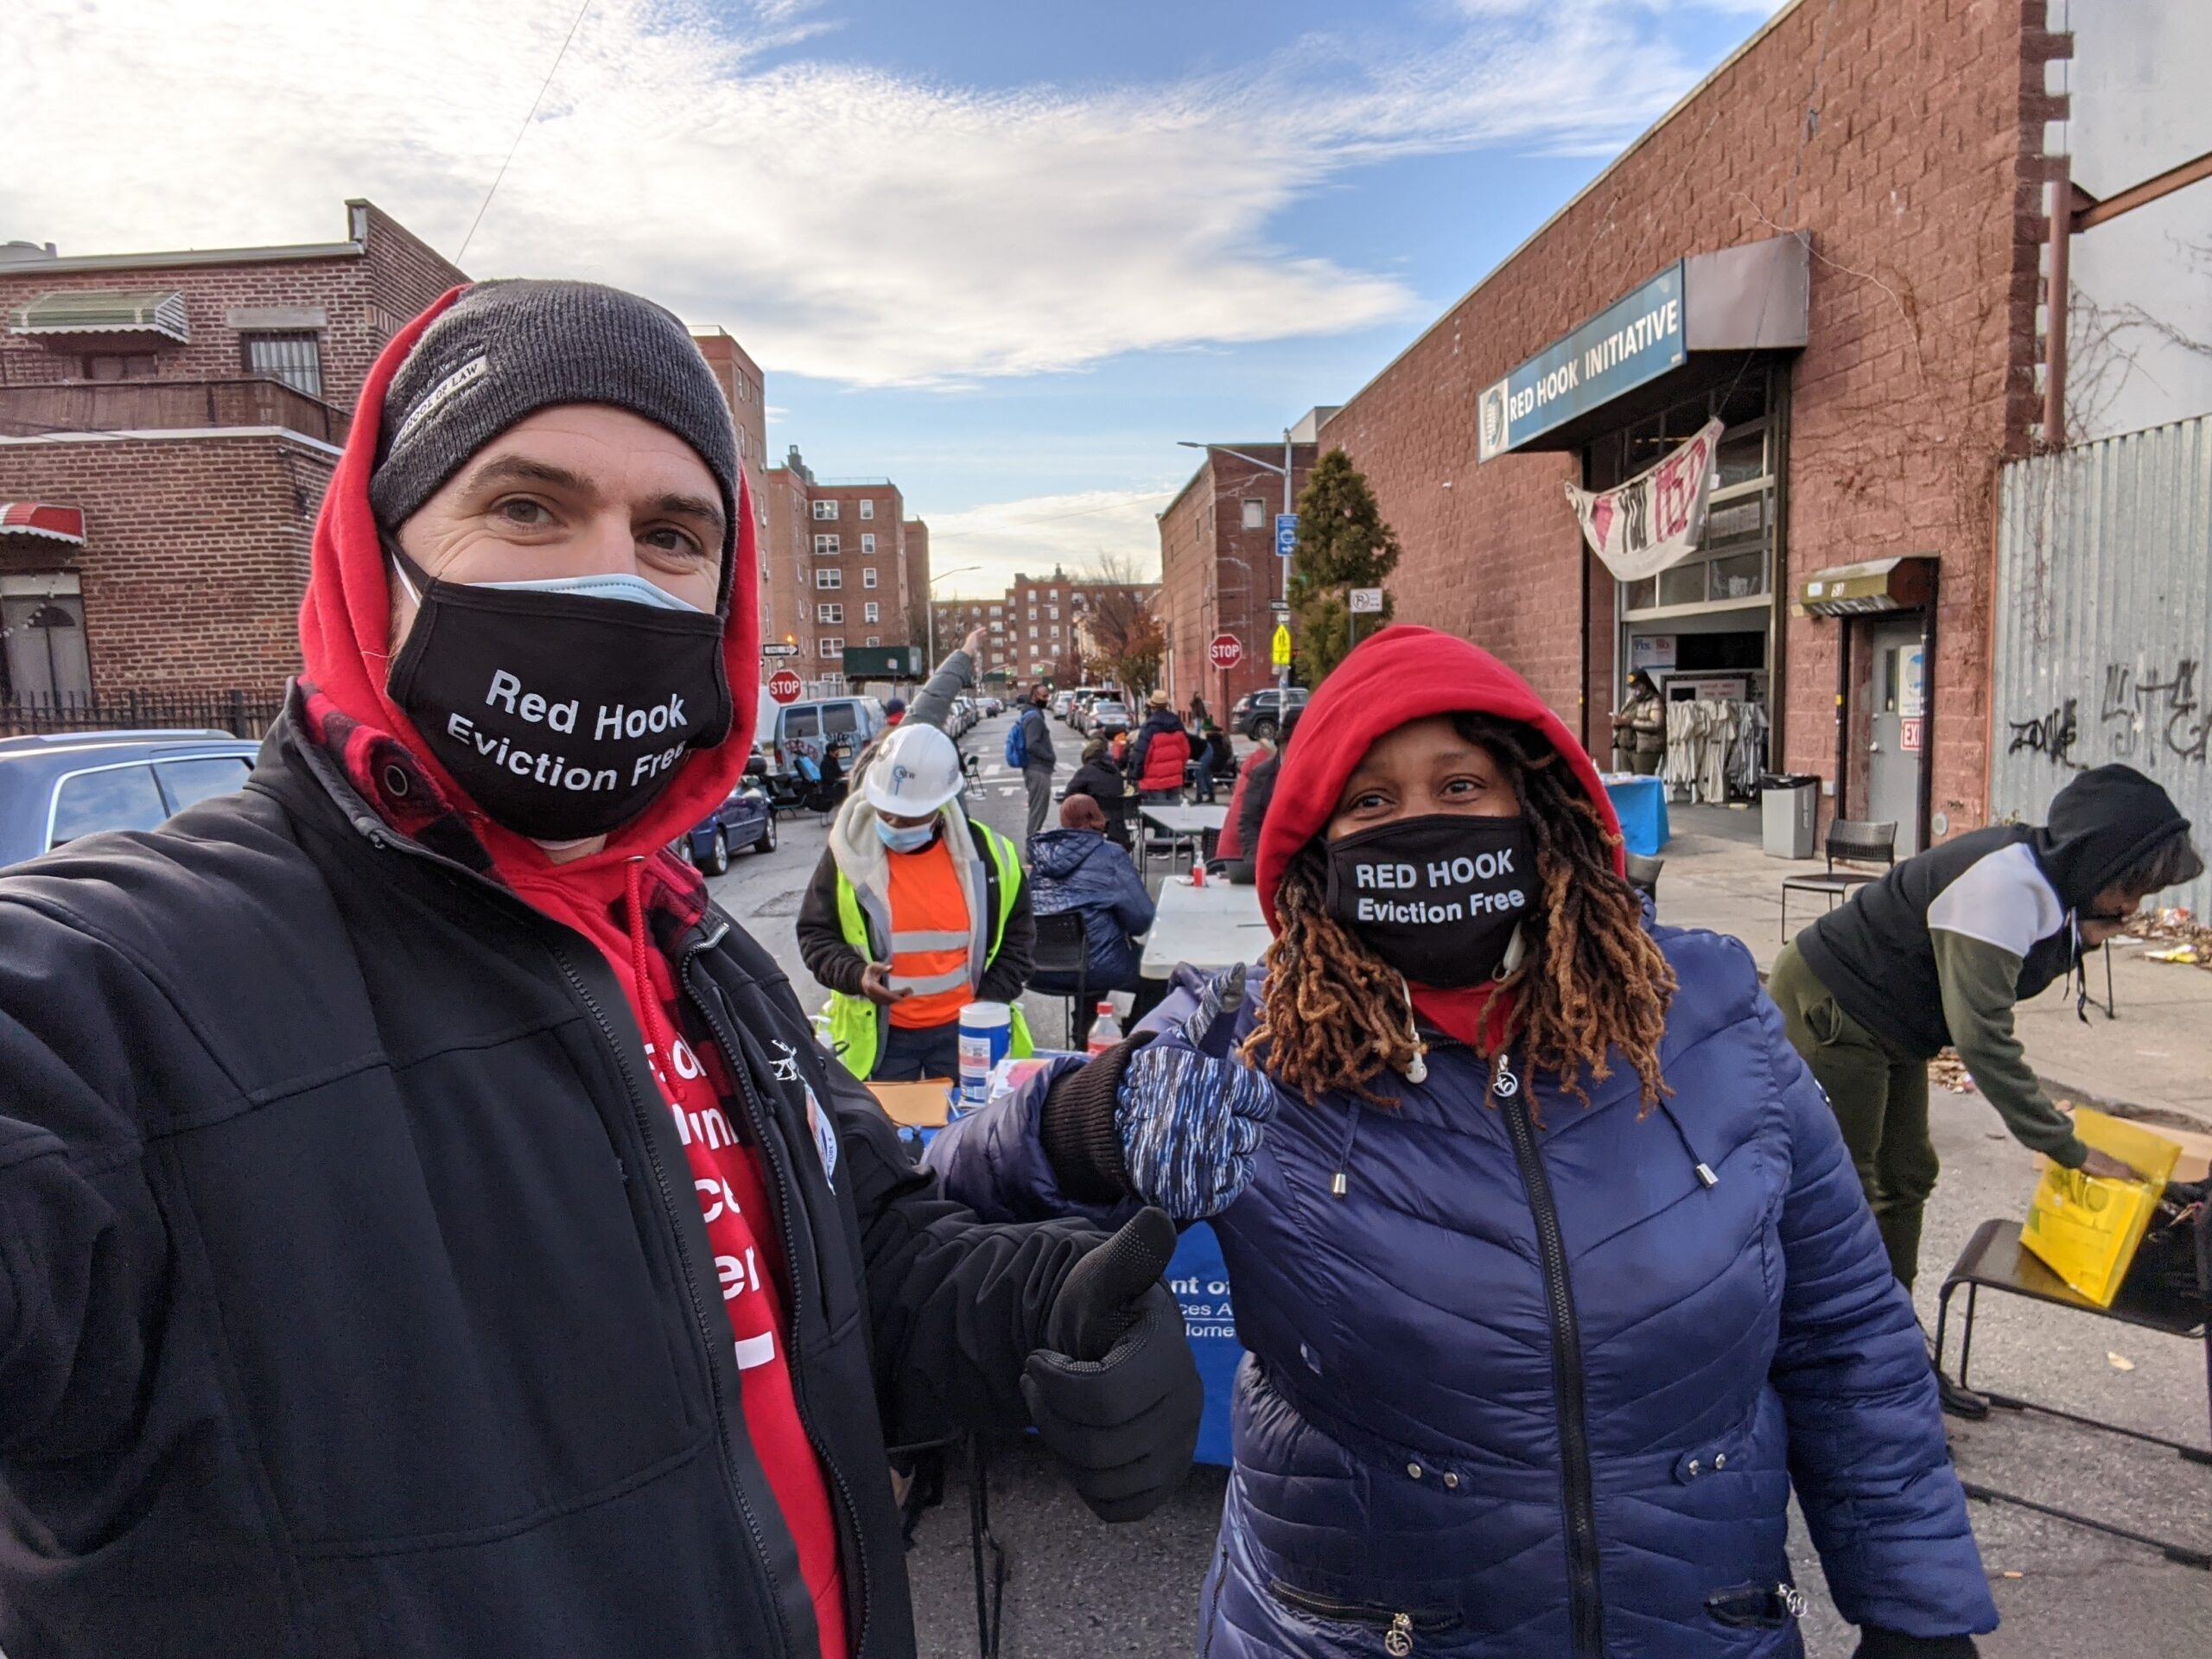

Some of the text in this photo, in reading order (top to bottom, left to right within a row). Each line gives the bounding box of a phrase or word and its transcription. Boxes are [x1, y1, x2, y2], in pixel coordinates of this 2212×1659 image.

[1509, 299, 1678, 423] RED HOOK INITIATIVE
[452, 363, 478, 386] LAW
[1211, 645, 1241, 658] STOP
[770, 681, 799, 695] STOP
[485, 669, 688, 741] Red Hook
[1904, 722, 1920, 747] EXI
[447, 712, 618, 791] Eviction
[1356, 849, 1515, 888] RED HOOK
[1357, 889, 1526, 924] Eviction Free
[1171, 1276, 1199, 1294] nt
[1217, 1302, 1233, 1316] A
